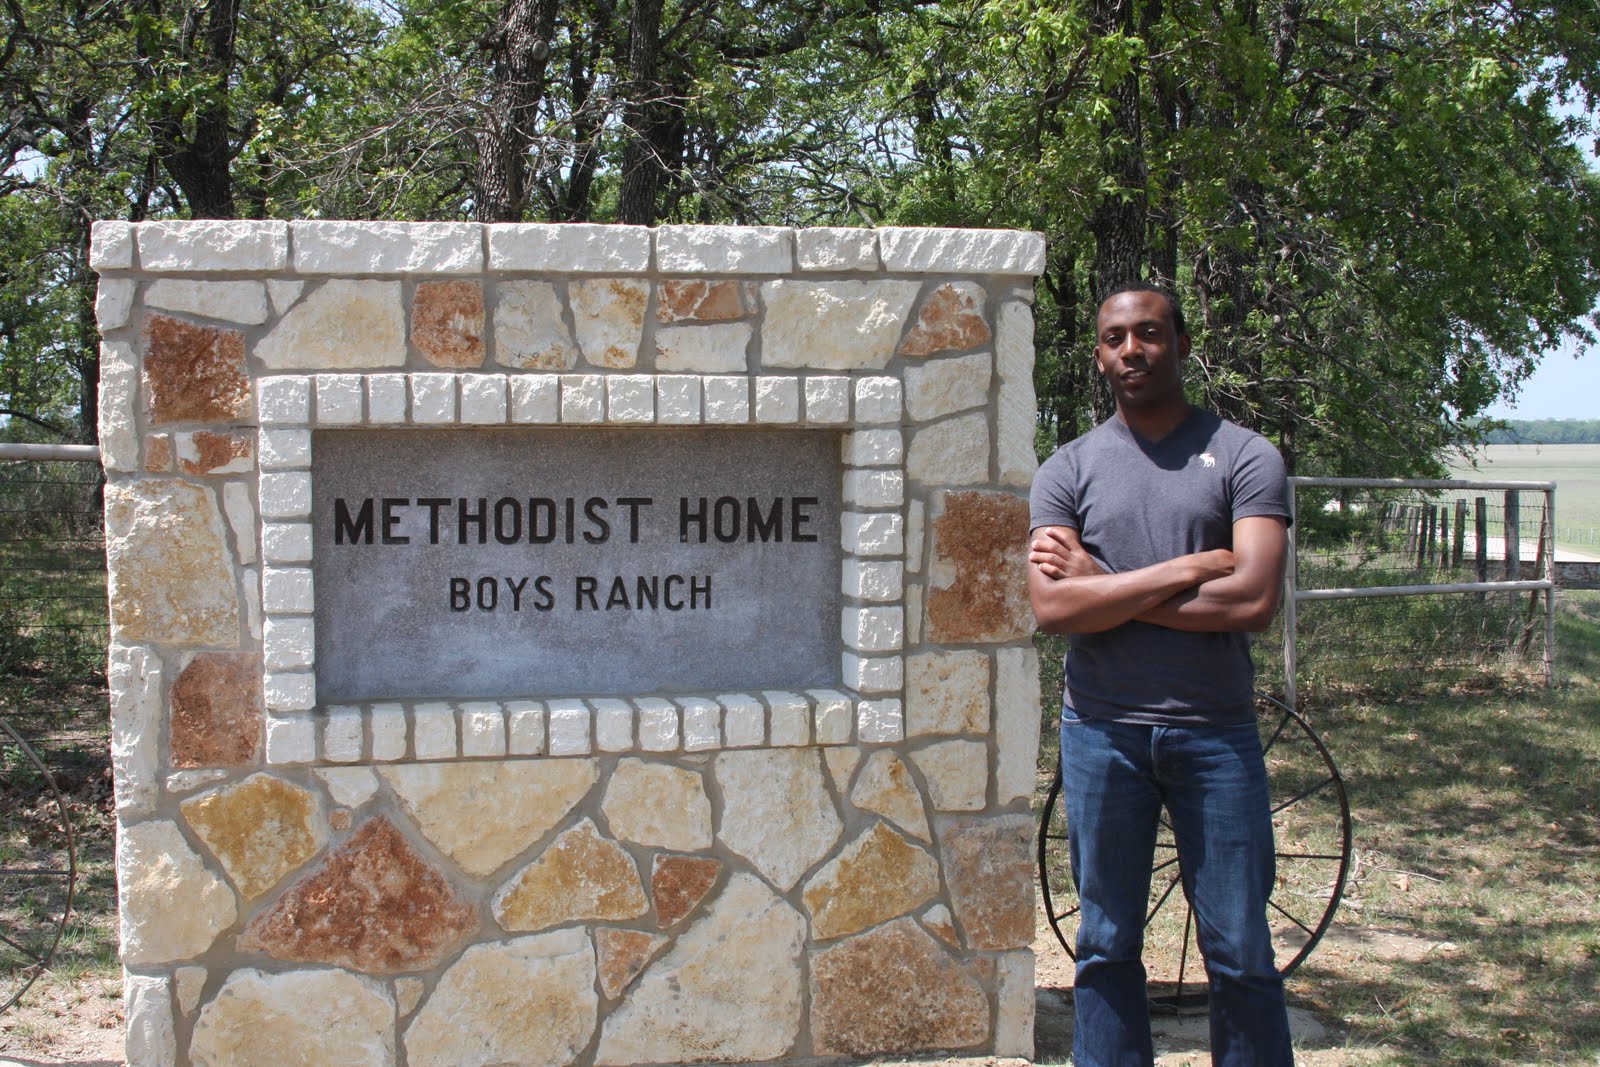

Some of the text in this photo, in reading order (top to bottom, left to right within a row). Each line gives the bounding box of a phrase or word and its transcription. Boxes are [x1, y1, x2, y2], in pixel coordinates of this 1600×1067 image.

[334, 496, 819, 545] METHODIST HOME
[450, 574, 713, 612] BOYS RANCH
